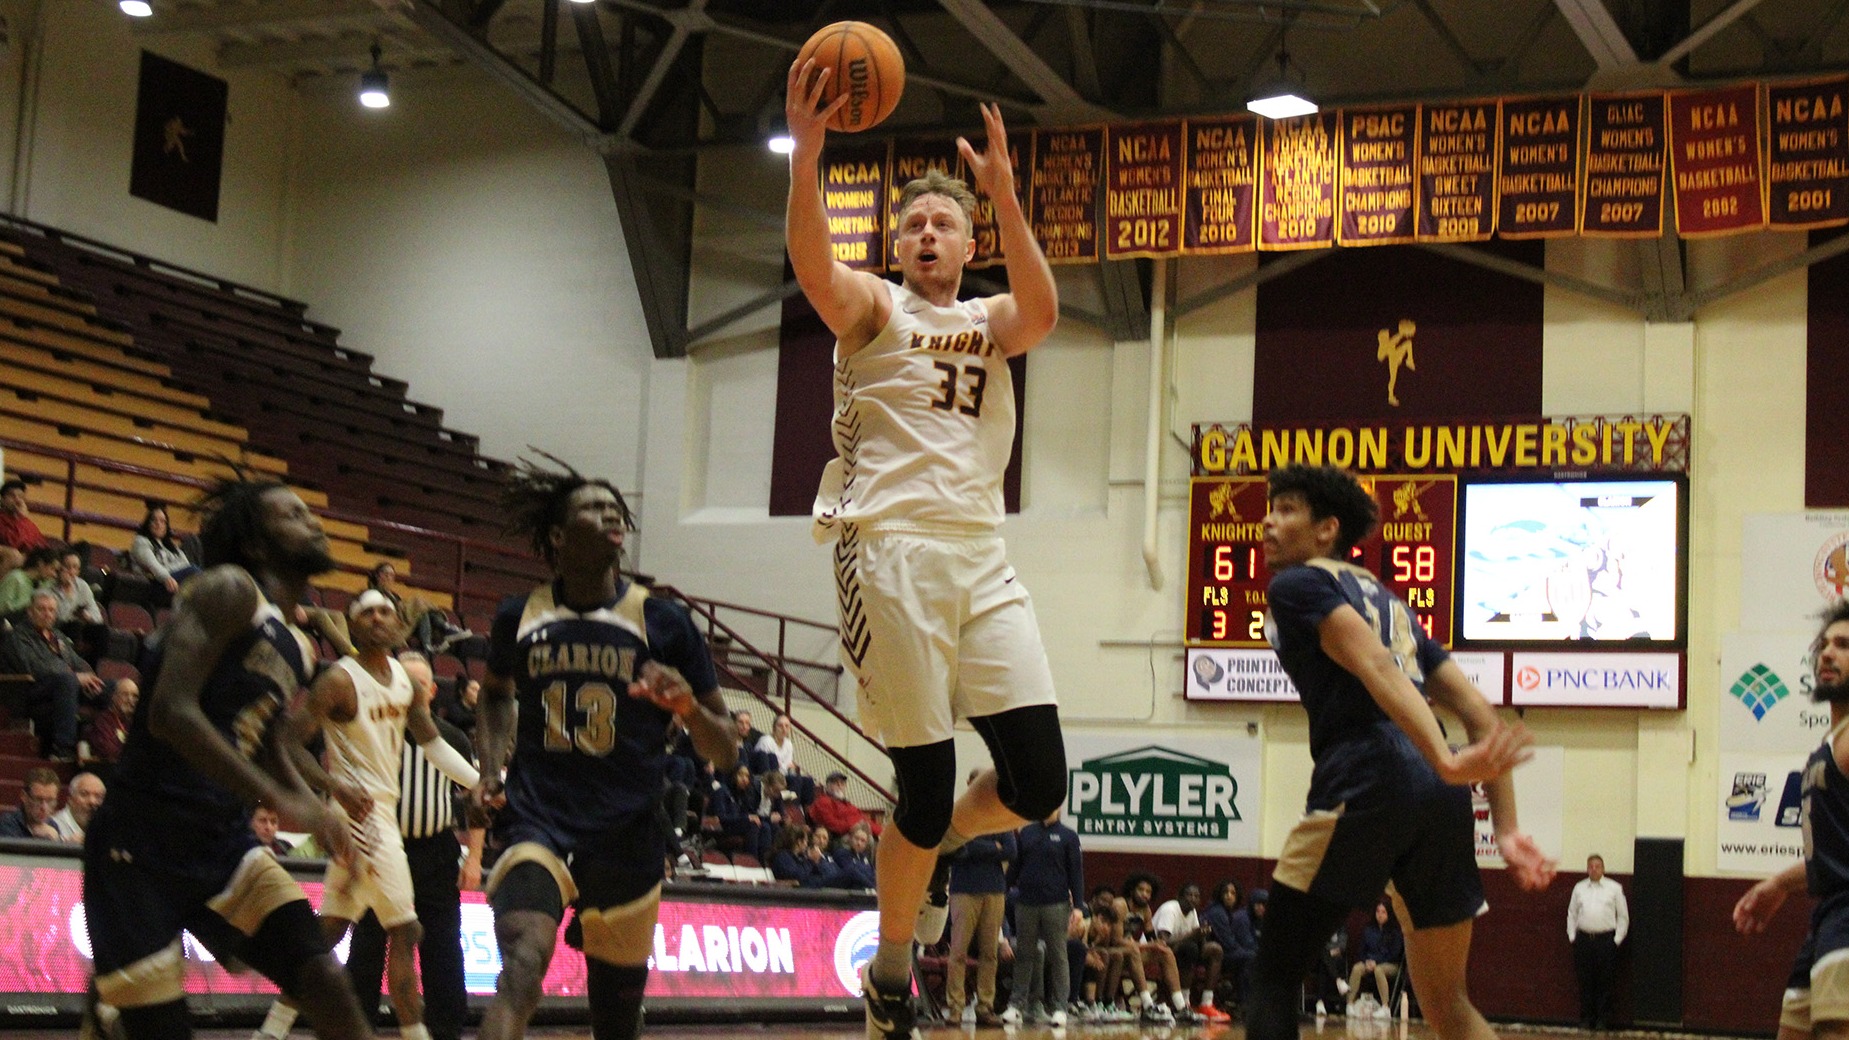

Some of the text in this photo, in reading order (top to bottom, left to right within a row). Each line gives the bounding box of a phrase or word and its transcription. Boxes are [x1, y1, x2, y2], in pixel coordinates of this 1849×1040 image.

[848, 57, 869, 126] Wilson
[1691, 102, 1738, 131] NCAA
[1776, 94, 1842, 123] NCAA
[1273, 117, 1325, 138] NCAA
[1352, 113, 1405, 138] PSAC
[1431, 108, 1486, 133] NCAA
[1510, 108, 1569, 136] NCAA
[1118, 134, 1170, 163] NCAA
[1196, 127, 1246, 149] NCAA
[1266, 149, 1333, 170] BASKETBALL
[1422, 154, 1492, 175] BASKETBALL
[1589, 152, 1662, 173] BASKETBALL
[1772, 158, 1849, 183] BASKETBALL
[829, 162, 881, 184] NCAA
[1188, 166, 1252, 188] BASKETBALL
[1272, 166, 1331, 186] ATLANTIC
[1344, 164, 1412, 187] BASKETBALL
[1502, 172, 1575, 195] BASKETBALL
[1679, 164, 1755, 191] BASKETBALL
[1202, 187, 1236, 206] FINAL
[1276, 183, 1321, 203] REGION
[1435, 175, 1478, 196] SWEET
[1591, 176, 1657, 198] CHAMPIONS
[1109, 187, 1179, 217] BASKETBALL
[1265, 198, 1331, 222] CHAMPIONS
[1346, 189, 1411, 212] CHAMPIONS
[1431, 195, 1482, 217] SIXTEEN
[1703, 195, 1738, 218] 2002
[1788, 188, 1831, 212] 2001
[1203, 203, 1234, 224] FOUR
[1515, 201, 1560, 223] 2007
[1601, 202, 1643, 223] 2007
[1117, 218, 1170, 248] 2012
[1200, 223, 1237, 243] 2010
[1278, 217, 1316, 239] 2010
[1358, 213, 1396, 234] 2010
[931, 361, 987, 418] 33
[1201, 422, 1673, 472] GANNON UNIVERSITY
[1202, 523, 1264, 541] KNIGHTS
[1383, 522, 1433, 541] GUEST
[1393, 546, 1435, 581] 58
[1203, 586, 1229, 606] FLS
[1408, 587, 1435, 608] FLS
[1213, 610, 1226, 639] 3
[1248, 610, 1265, 640] 2
[528, 643, 637, 683] CLARION
[1227, 658, 1284, 673] PRINTIN
[541, 680, 617, 758] 13
[1800, 711, 1830, 730] Spo
[1071, 771, 1236, 818] PLYLER
[1084, 818, 1219, 837] ENTRY SYSTEMS
[647, 923, 795, 974] LARION
